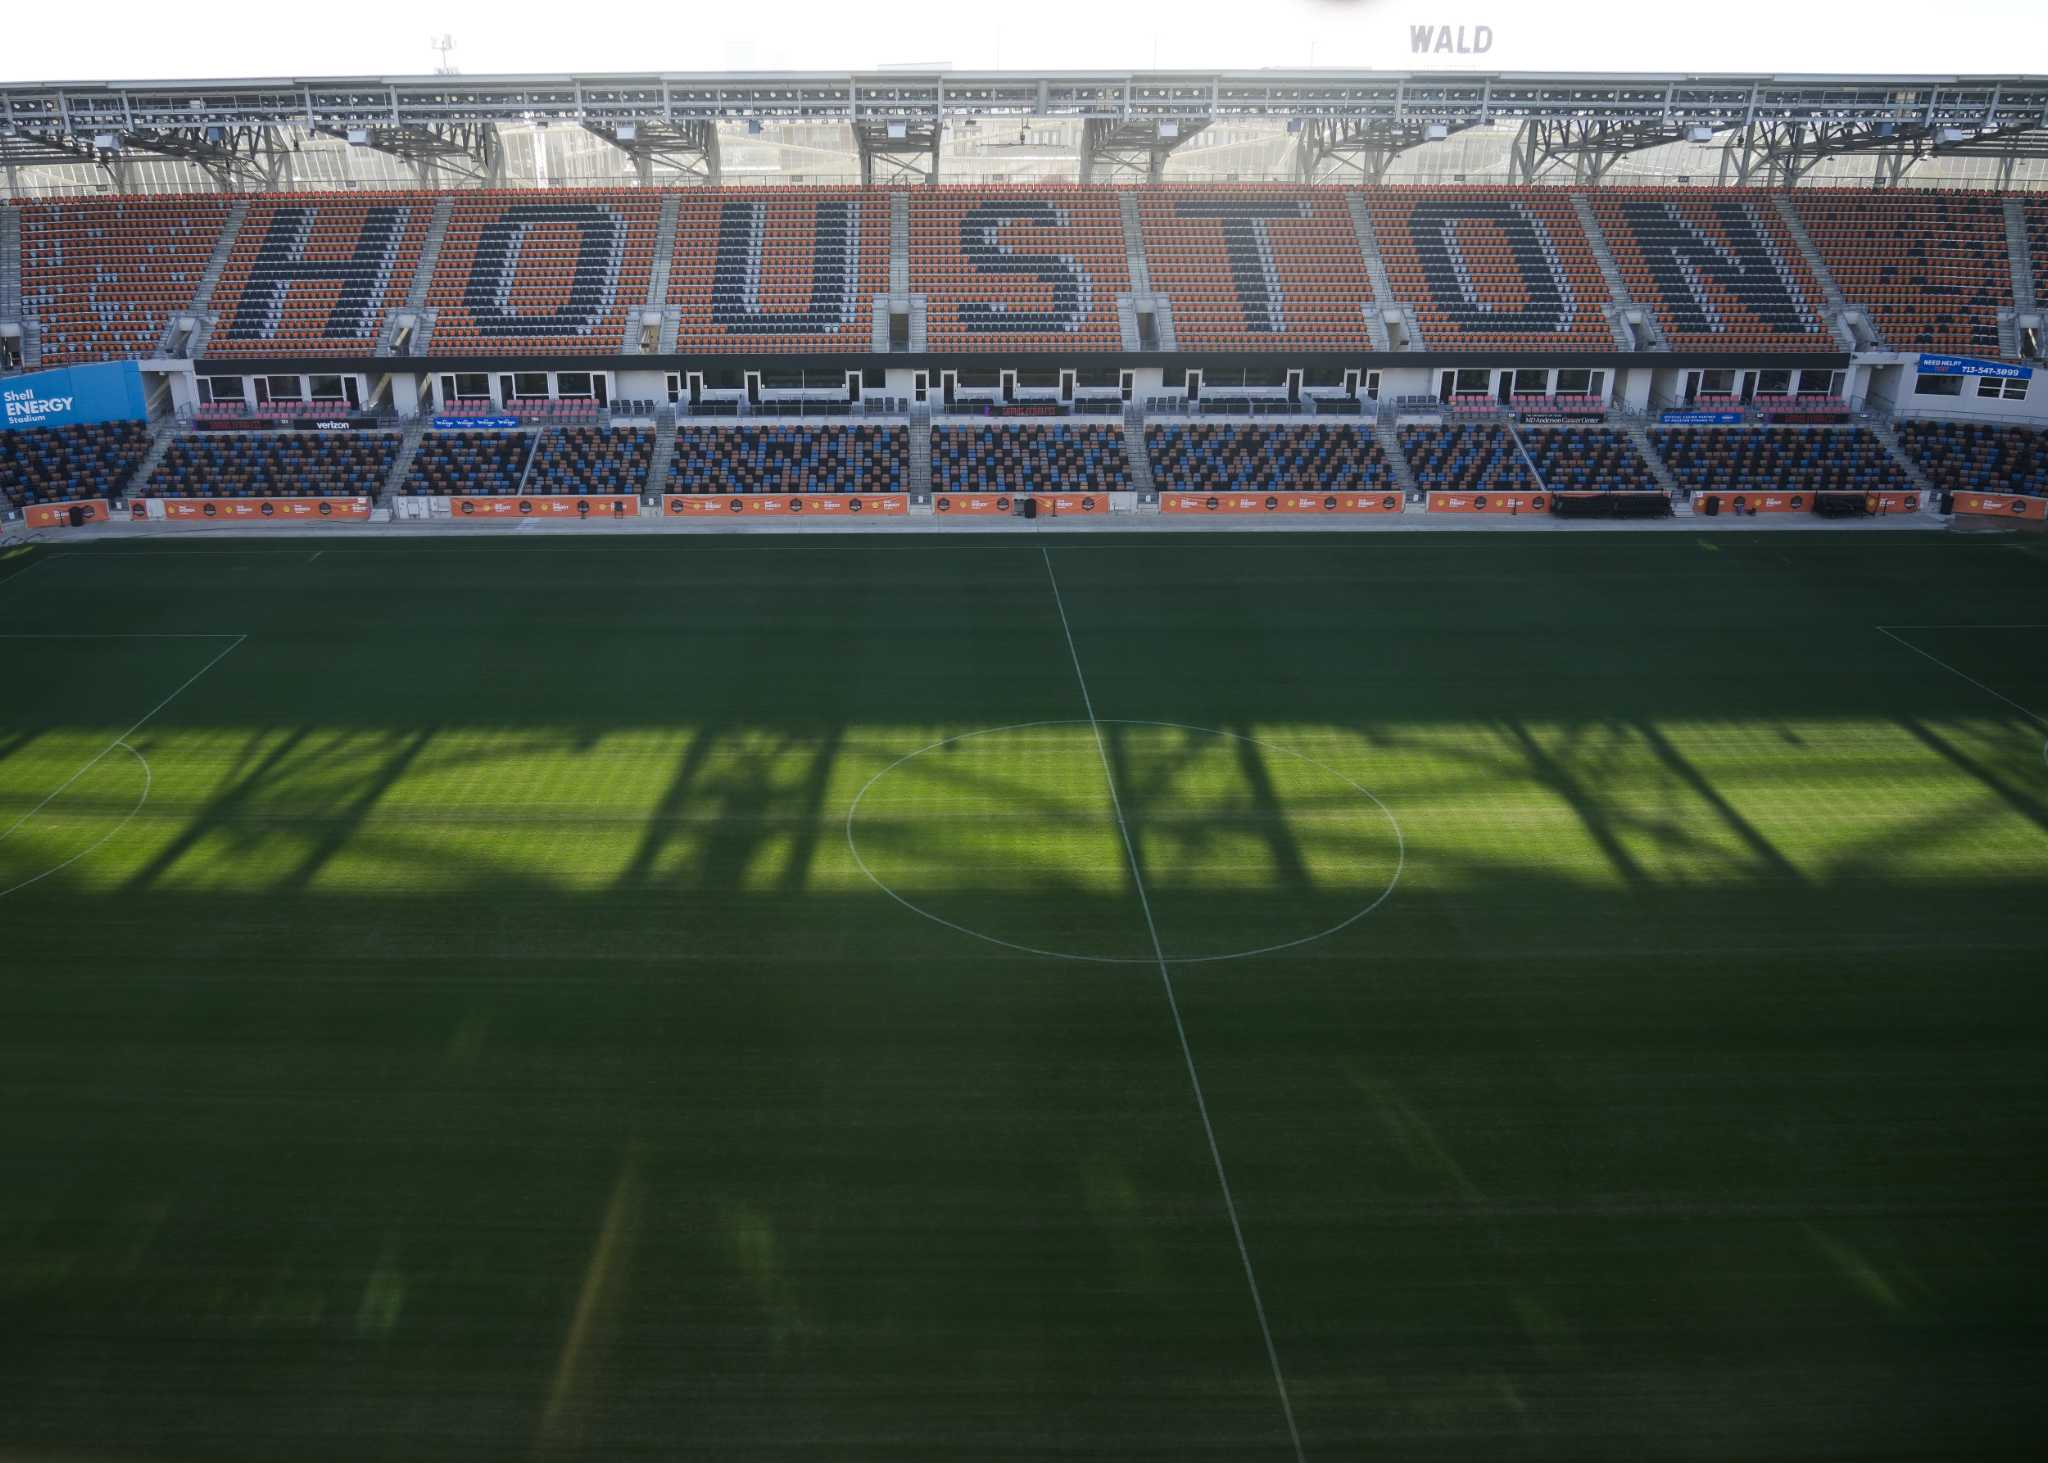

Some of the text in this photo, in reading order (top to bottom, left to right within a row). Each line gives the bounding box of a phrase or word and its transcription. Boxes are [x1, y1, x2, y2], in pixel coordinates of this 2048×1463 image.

[1410, 25, 1493, 53] WALD
[228, 200, 1819, 338] HOUSTON
[4, 388, 34, 402] Shell
[6, 397, 73, 416] ENERGY
[8, 414, 46, 424] Stadium
[316, 421, 350, 429] verizon
